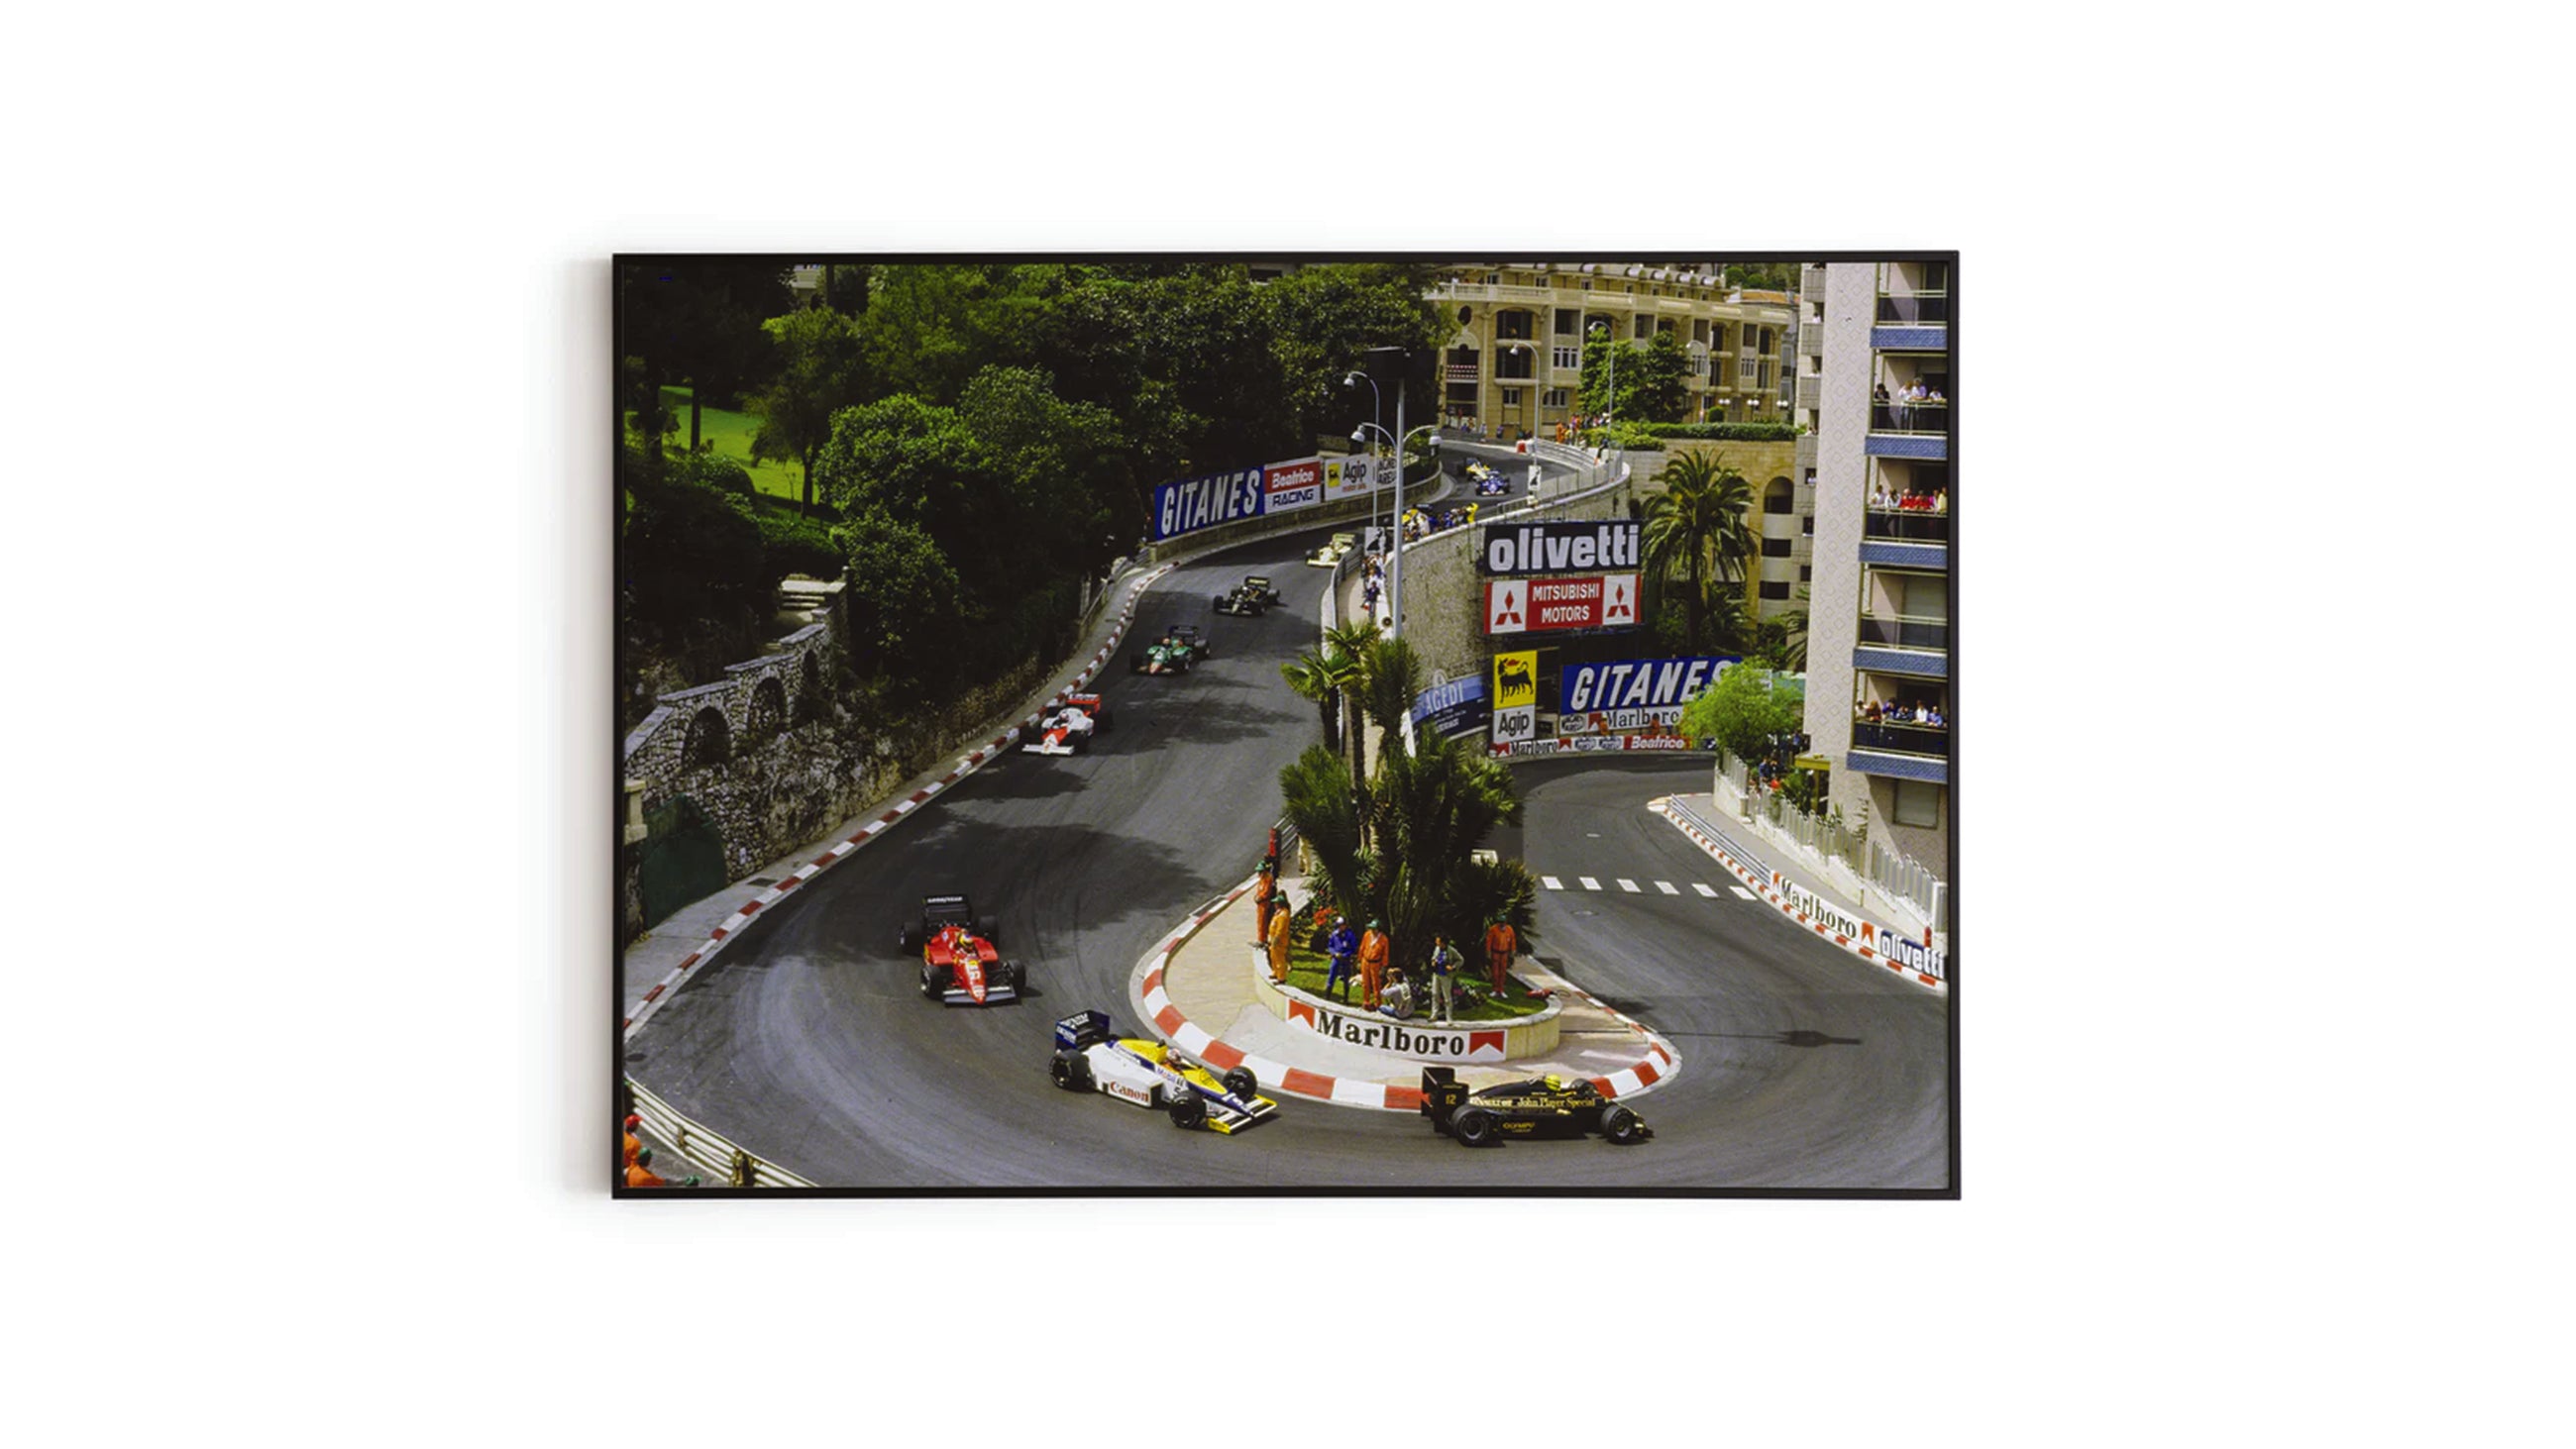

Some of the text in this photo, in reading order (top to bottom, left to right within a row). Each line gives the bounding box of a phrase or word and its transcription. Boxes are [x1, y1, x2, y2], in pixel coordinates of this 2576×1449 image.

[1271, 467, 1315, 489] Beatrice
[1342, 460, 1366, 483] Agip
[1161, 469, 1260, 535] GITANES
[1272, 488, 1314, 507] RACING
[1489, 525, 1640, 571] olivetti
[1533, 583, 1601, 601] MITSUBISHI
[1542, 605, 1590, 623] MOTORS
[1498, 711, 1530, 737] Agip
[1631, 736, 1684, 750] Beatrice
[1780, 878, 1858, 939] Marlboro
[1882, 934, 1945, 980] olivetti
[1317, 1010, 1464, 1056] Marlboro
[1110, 1081, 1149, 1102] Canon
[1517, 1095, 1539, 1106] John
[1566, 1097, 1595, 1108] Special
